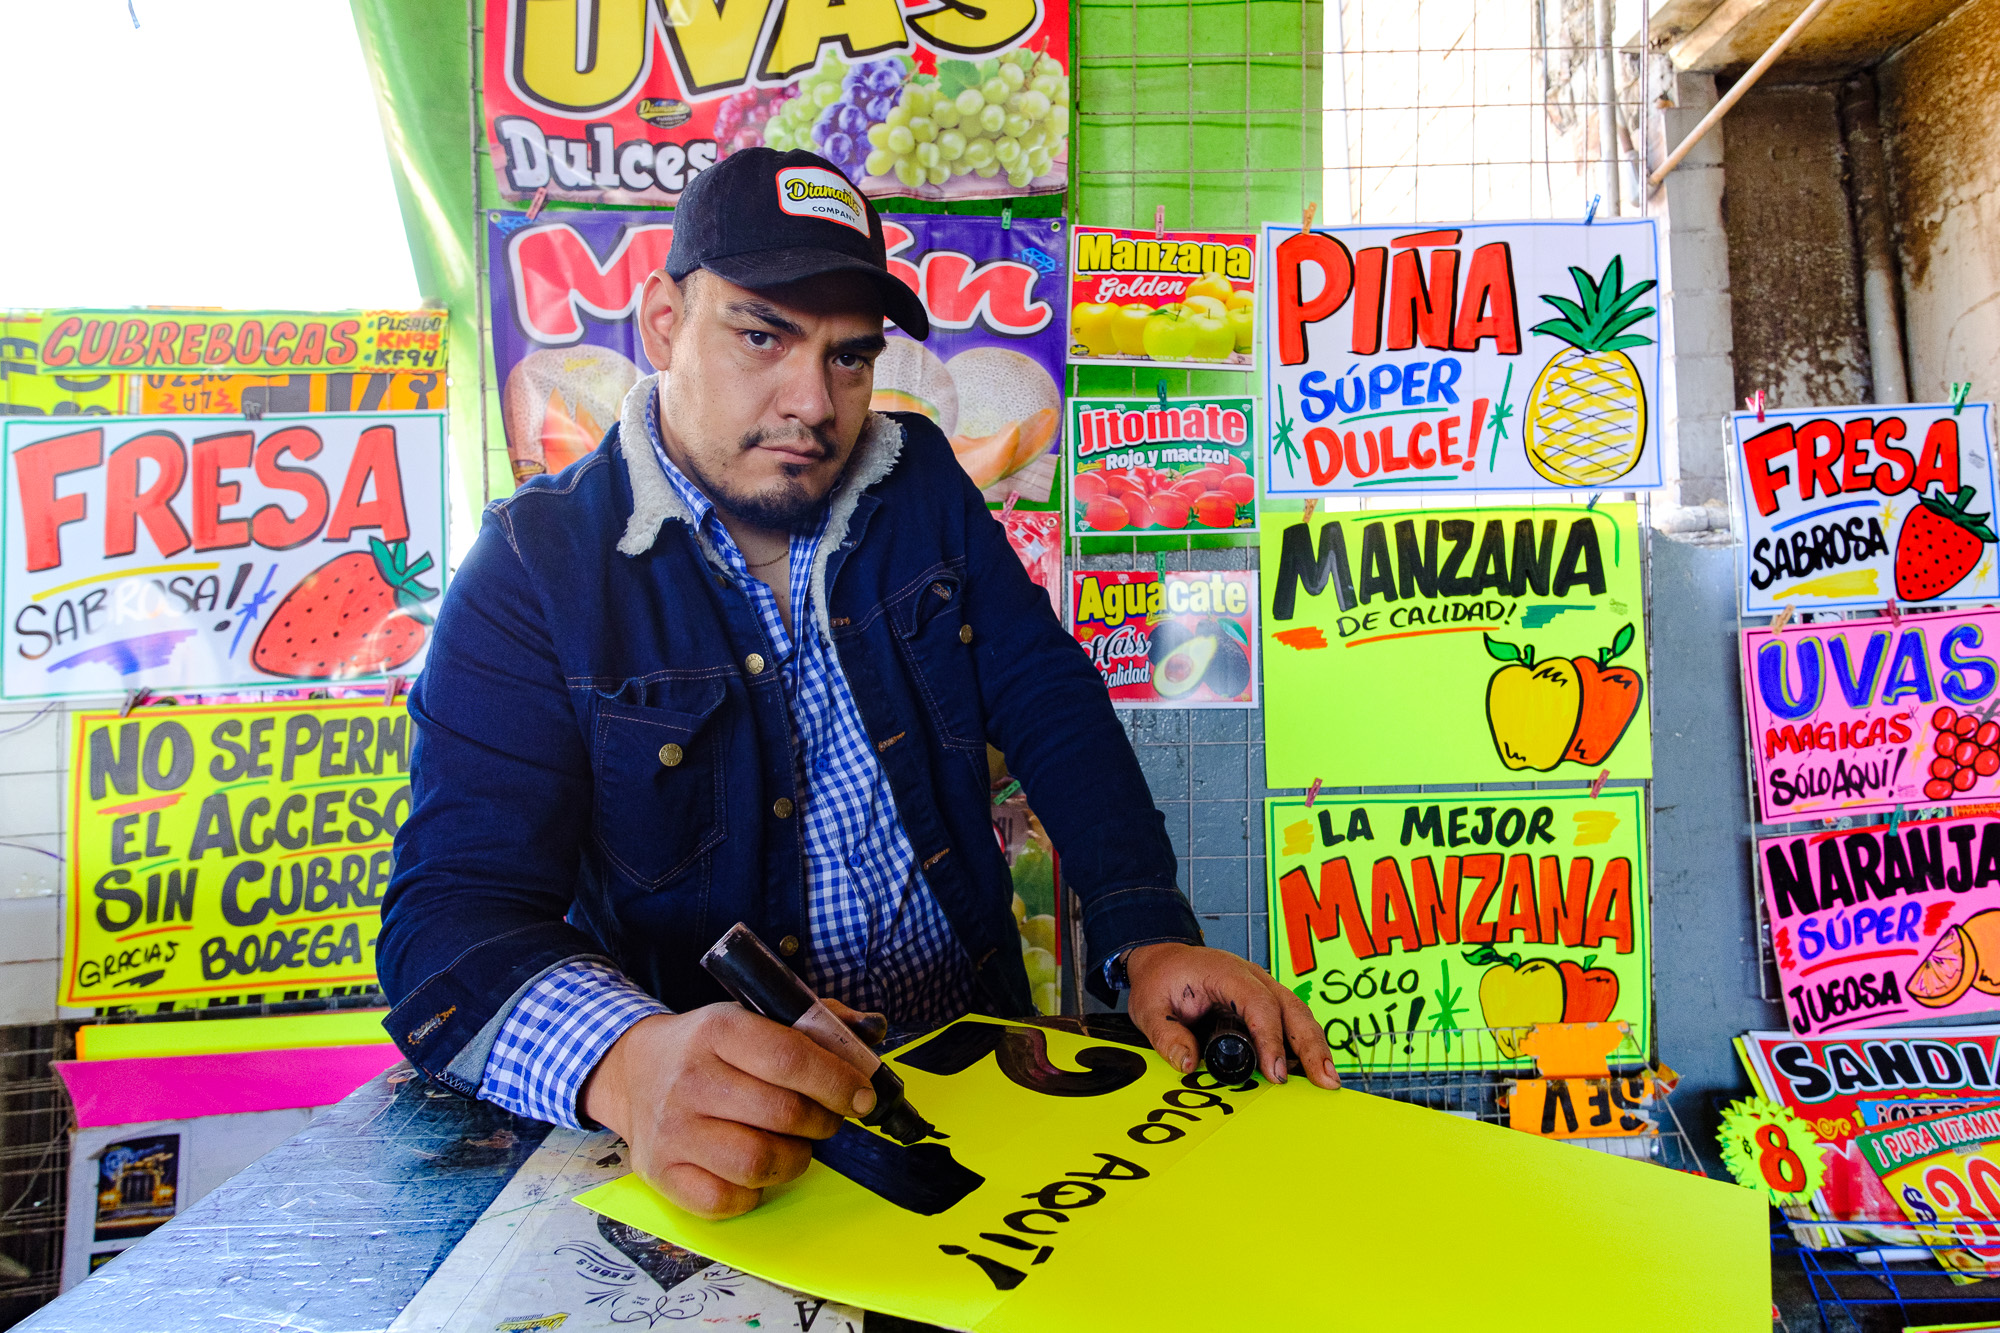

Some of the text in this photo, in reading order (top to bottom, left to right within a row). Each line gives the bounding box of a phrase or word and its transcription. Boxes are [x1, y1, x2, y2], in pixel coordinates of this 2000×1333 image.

[498, 116, 717, 191] Dulces
[812, 206, 856, 224] COMPANY
[1078, 234, 1251, 279] Manzana
[1095, 276, 1186, 303] Golden
[1276, 229, 1521, 365] PIÑA
[42, 318, 361, 367] CUBREBOCAS
[375, 349, 437, 367] KF94
[376, 331, 440, 351] KN95
[1300, 358, 1462, 423] SÚPER
[1078, 404, 1247, 456] Jitomate
[1106, 449, 1145, 471] Rojo
[1146, 450, 1159, 468] y
[1162, 445, 1229, 465] macizo!
[1303, 398, 1489, 486] DULCE!
[1743, 417, 1961, 517] FRESA
[13, 424, 410, 573] FRESA
[1272, 517, 1607, 620] MANZANA
[1750, 517, 1890, 590] SABROSA
[15, 562, 253, 660] SABROSA!
[1076, 573, 1248, 629] Aguacate
[1336, 600, 1517, 638] DE CALIDAD!
[1082, 624, 1152, 668] Hass
[1757, 622, 2000, 722] UVAS
[89, 713, 410, 801] NO SE PERM
[1765, 712, 1913, 760] MAGICAS
[1770, 747, 1908, 807] SÓLO AQUÍ!
[111, 785, 412, 866] EL ACCESO
[1318, 805, 1556, 848] LA MEJOR
[94, 849, 391, 932] SIN CUBRE
[1279, 852, 1634, 976] MANZANA
[1798, 901, 1922, 961] SÚPER
[78, 941, 179, 989] GRACIAS
[1320, 966, 1419, 1005] SÓLO
[1323, 996, 1426, 1058] QUÍ!
[1788, 971, 1902, 1035] JUGOSA
[1772, 1040, 2000, 1102] SANDI
[1127, 1071, 1259, 1144] SÓLO
[1930, 1109, 2000, 1147] VITAMI
[939, 1153, 1151, 1291] AQUÍ!
